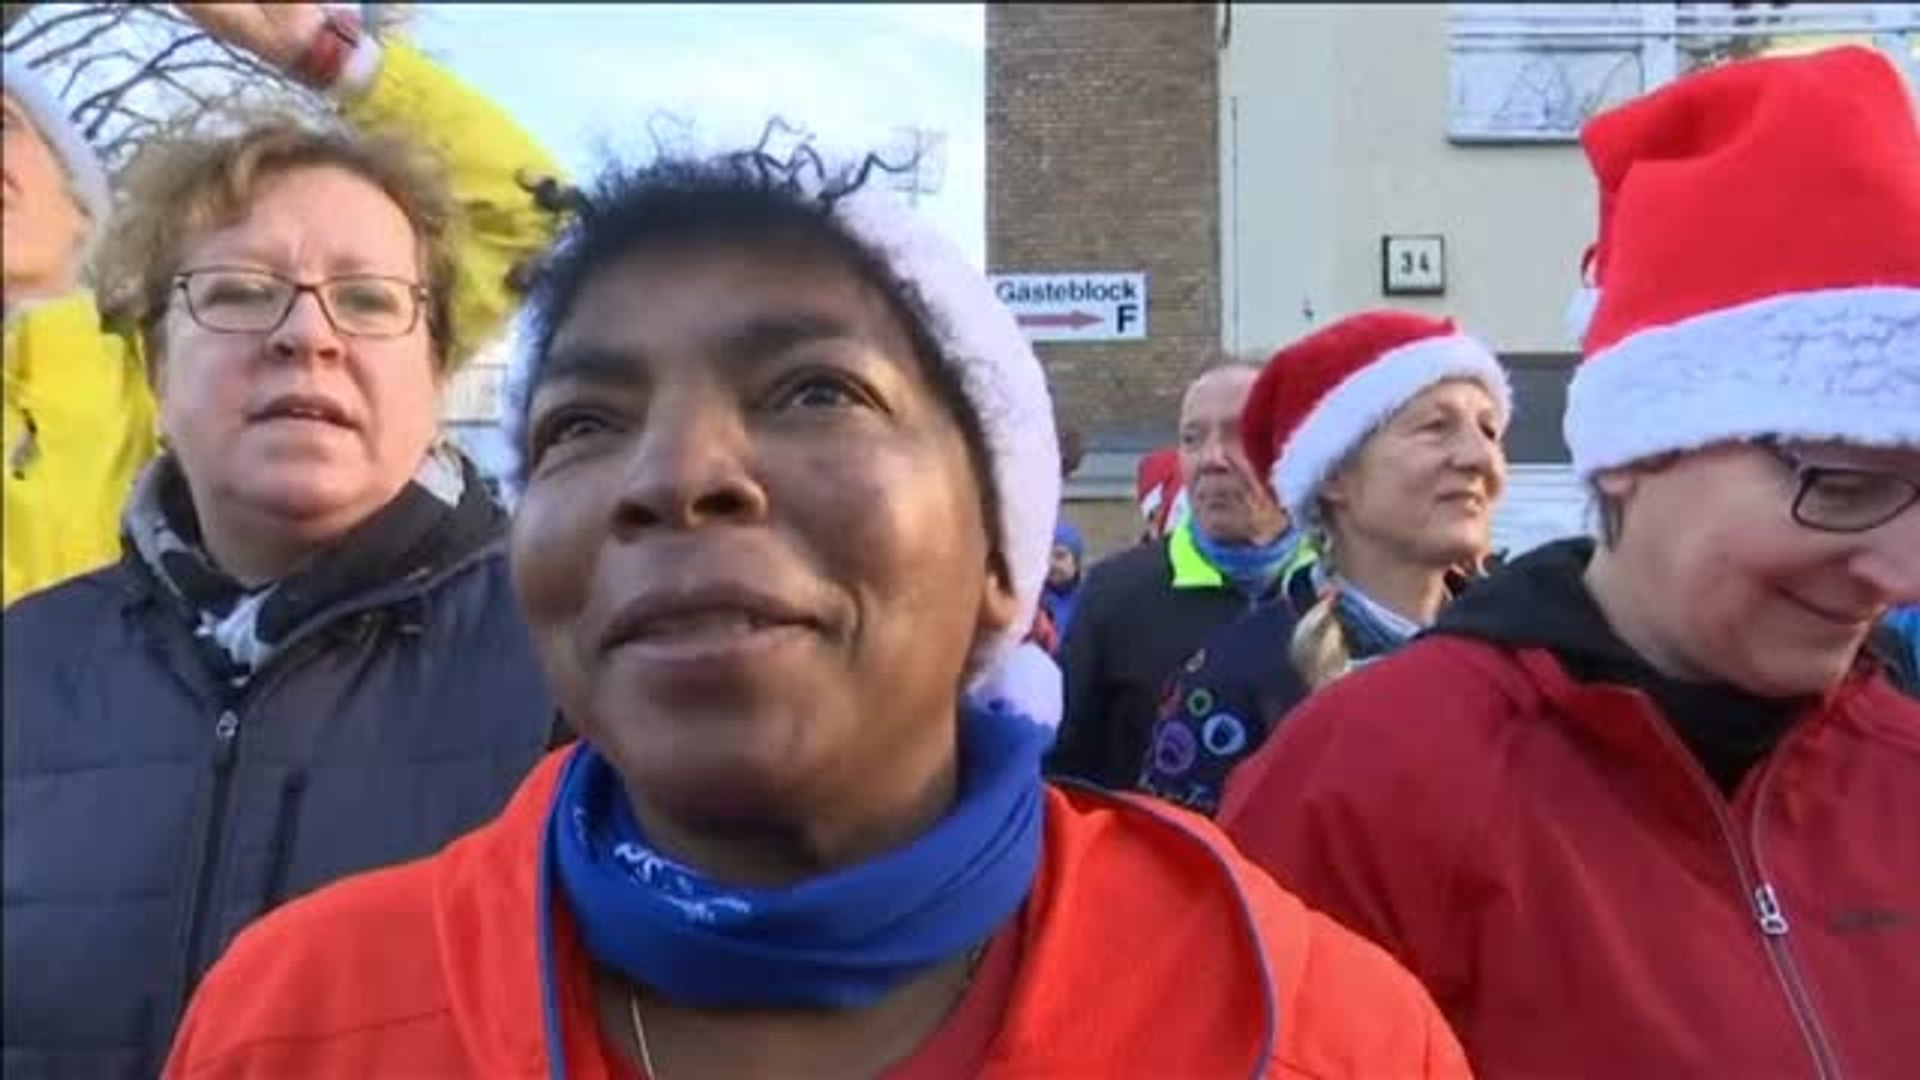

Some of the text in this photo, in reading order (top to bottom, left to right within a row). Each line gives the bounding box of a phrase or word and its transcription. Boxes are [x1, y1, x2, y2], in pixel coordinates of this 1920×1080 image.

[1401, 251, 1430, 274] 34
[995, 279, 1137, 302] Gästeblock
[1116, 305, 1138, 333] F
